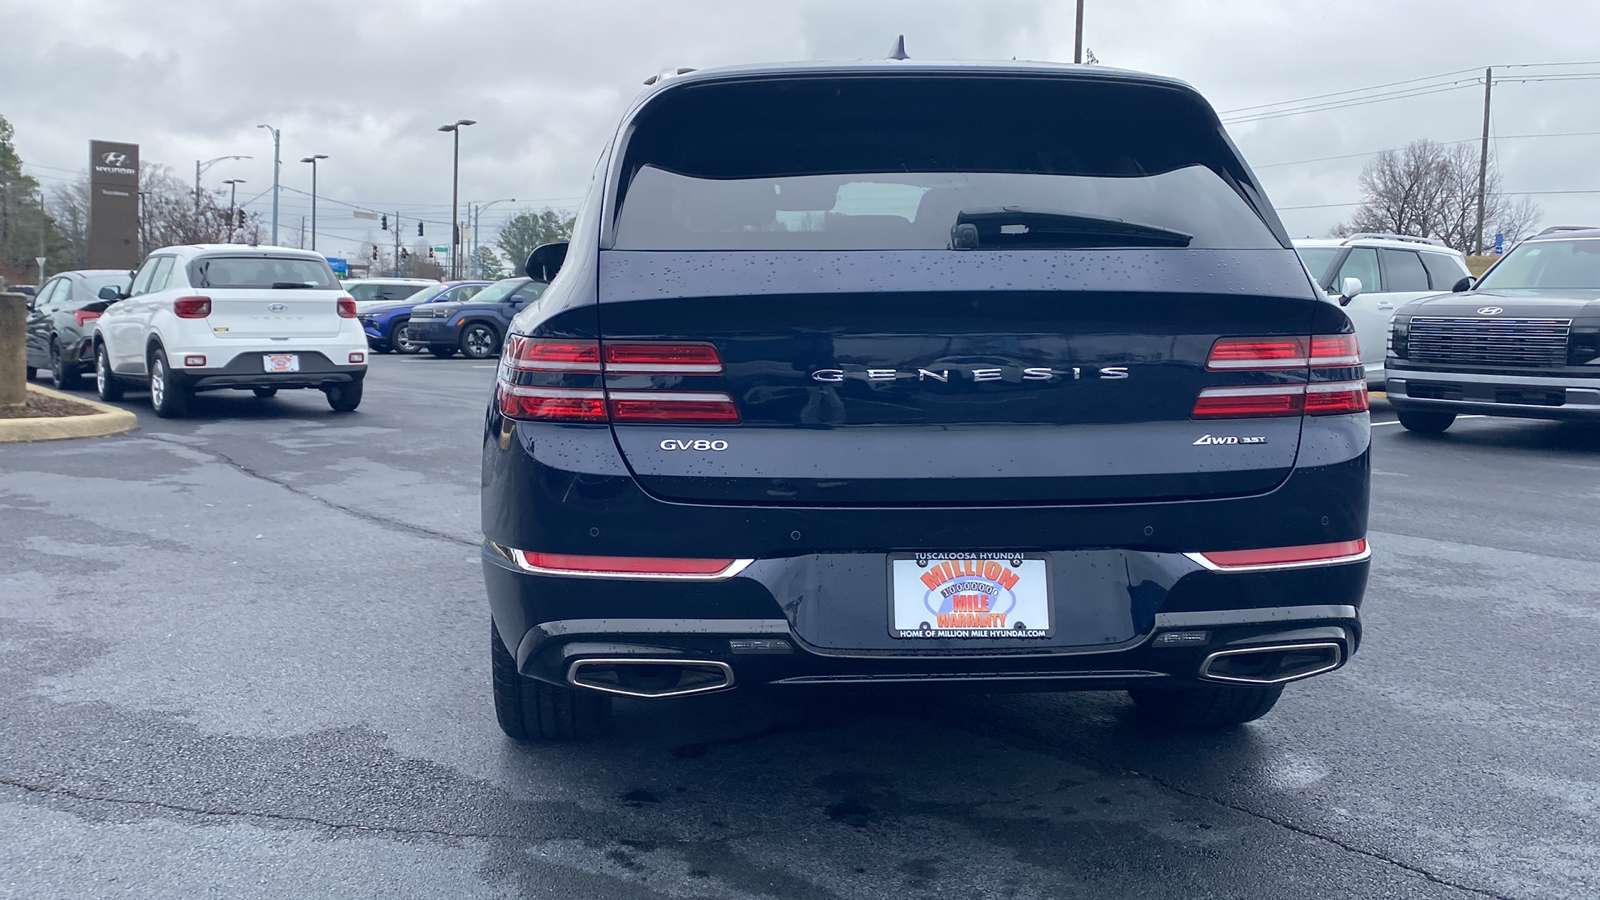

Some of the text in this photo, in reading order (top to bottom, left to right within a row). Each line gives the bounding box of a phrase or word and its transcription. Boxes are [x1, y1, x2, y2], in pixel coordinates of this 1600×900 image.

[95, 166, 135, 174] HYUNDAI
[811, 367, 1130, 383] GENESIS
[660, 439, 728, 451] GV80
[914, 552, 1024, 560] TUSCALOOSA HYUNDAI
[920, 560, 1020, 591] MILLION
[952, 594, 990, 613] MILE
[936, 613, 1007, 628] WARRANTY
[900, 630, 1046, 638] HOME OF MILLION MILE HYUNDAI.COM
